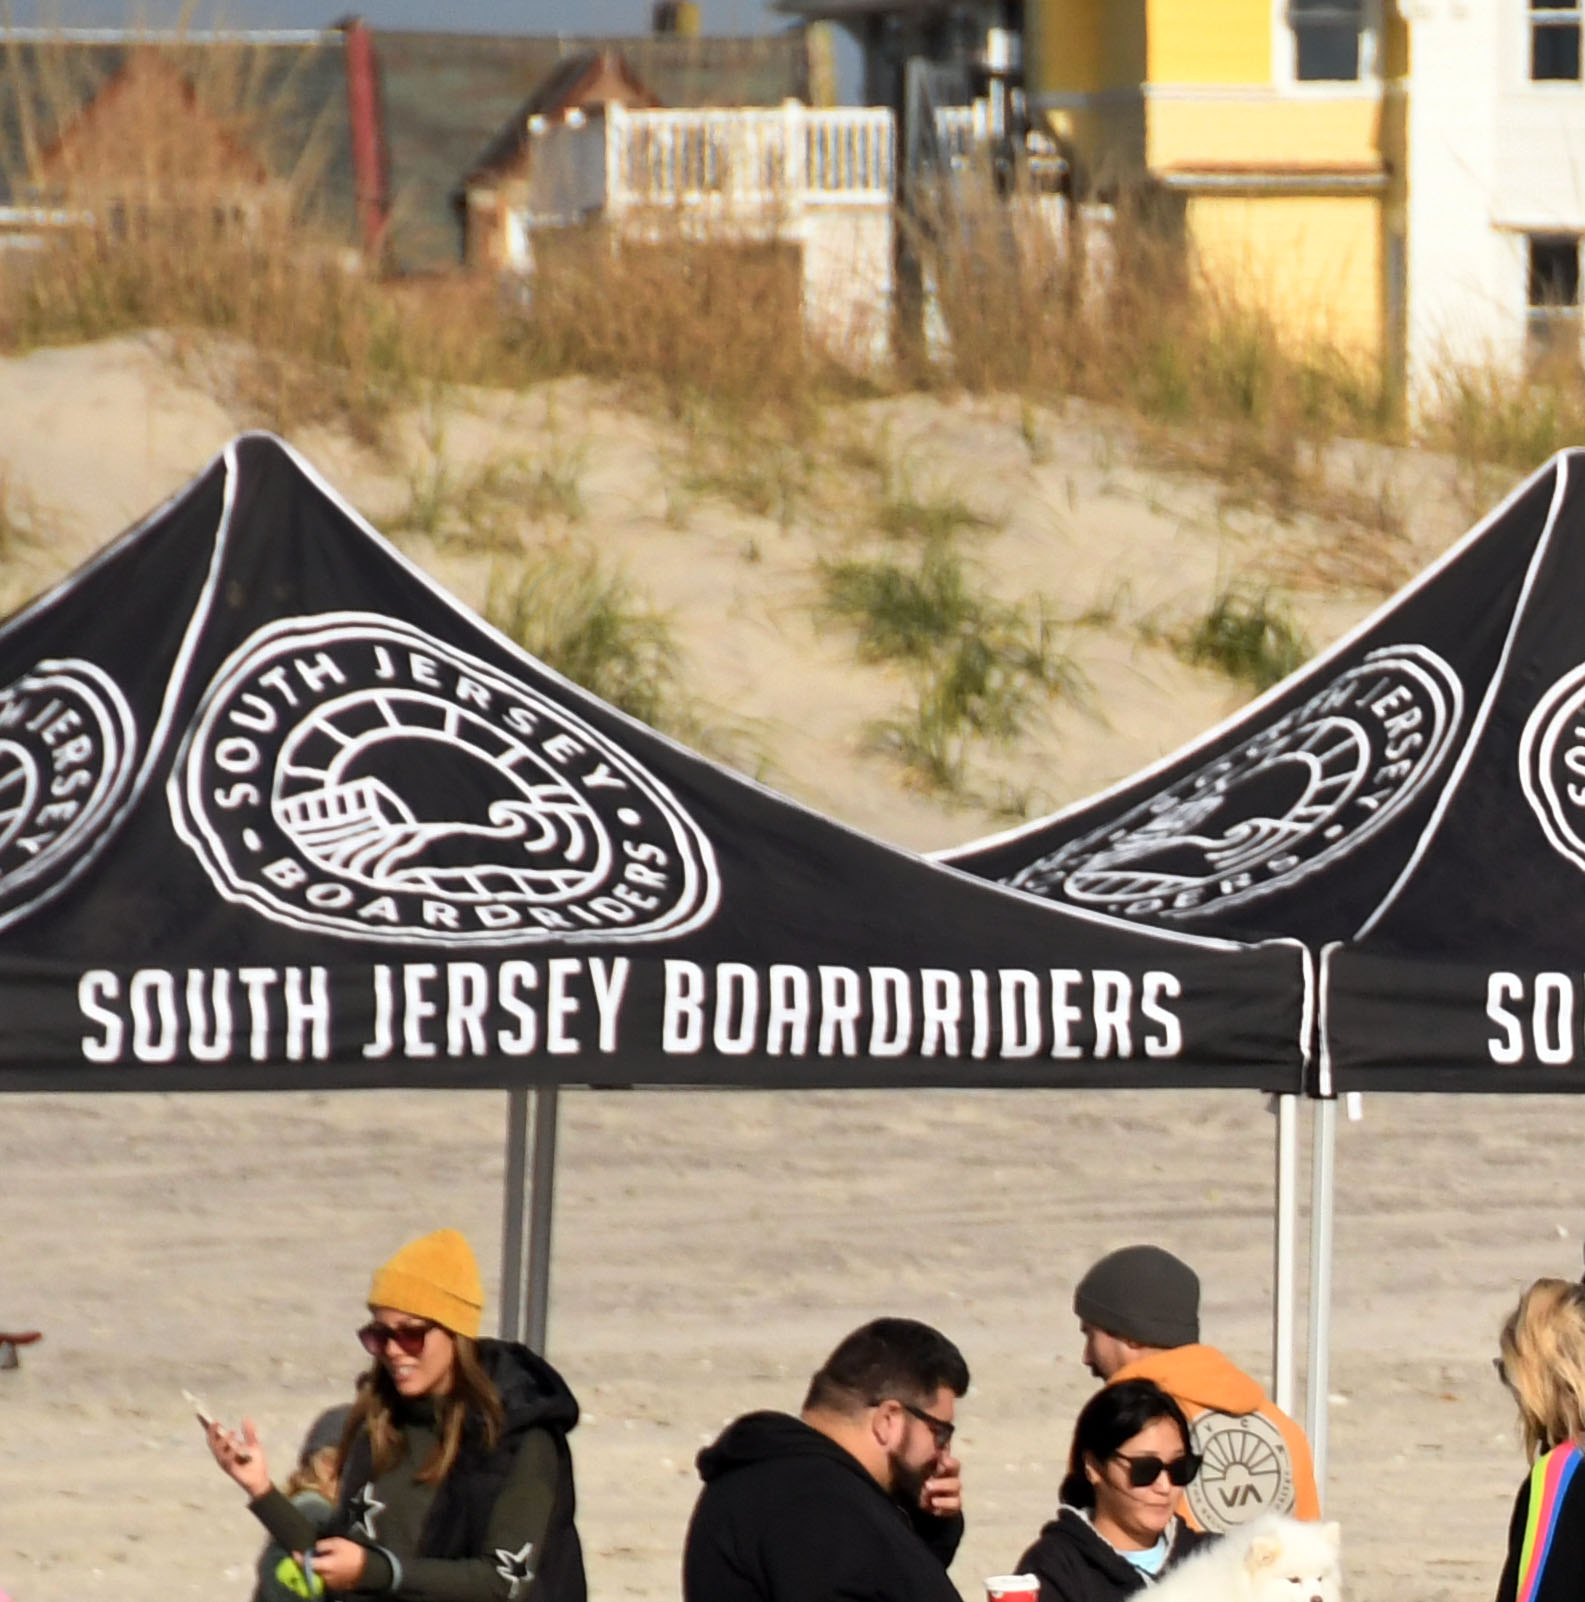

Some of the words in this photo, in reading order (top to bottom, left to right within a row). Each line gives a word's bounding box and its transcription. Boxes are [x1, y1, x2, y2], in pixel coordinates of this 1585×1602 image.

[213, 652, 346, 809] SOUTH
[374, 645, 627, 789] JERSEY
[261, 840, 668, 929] BOARDRIDERS
[77, 966, 330, 1063] SOUTH
[362, 956, 630, 1058] JERSEY
[662, 959, 1184, 1059] BOARDRIDERS
